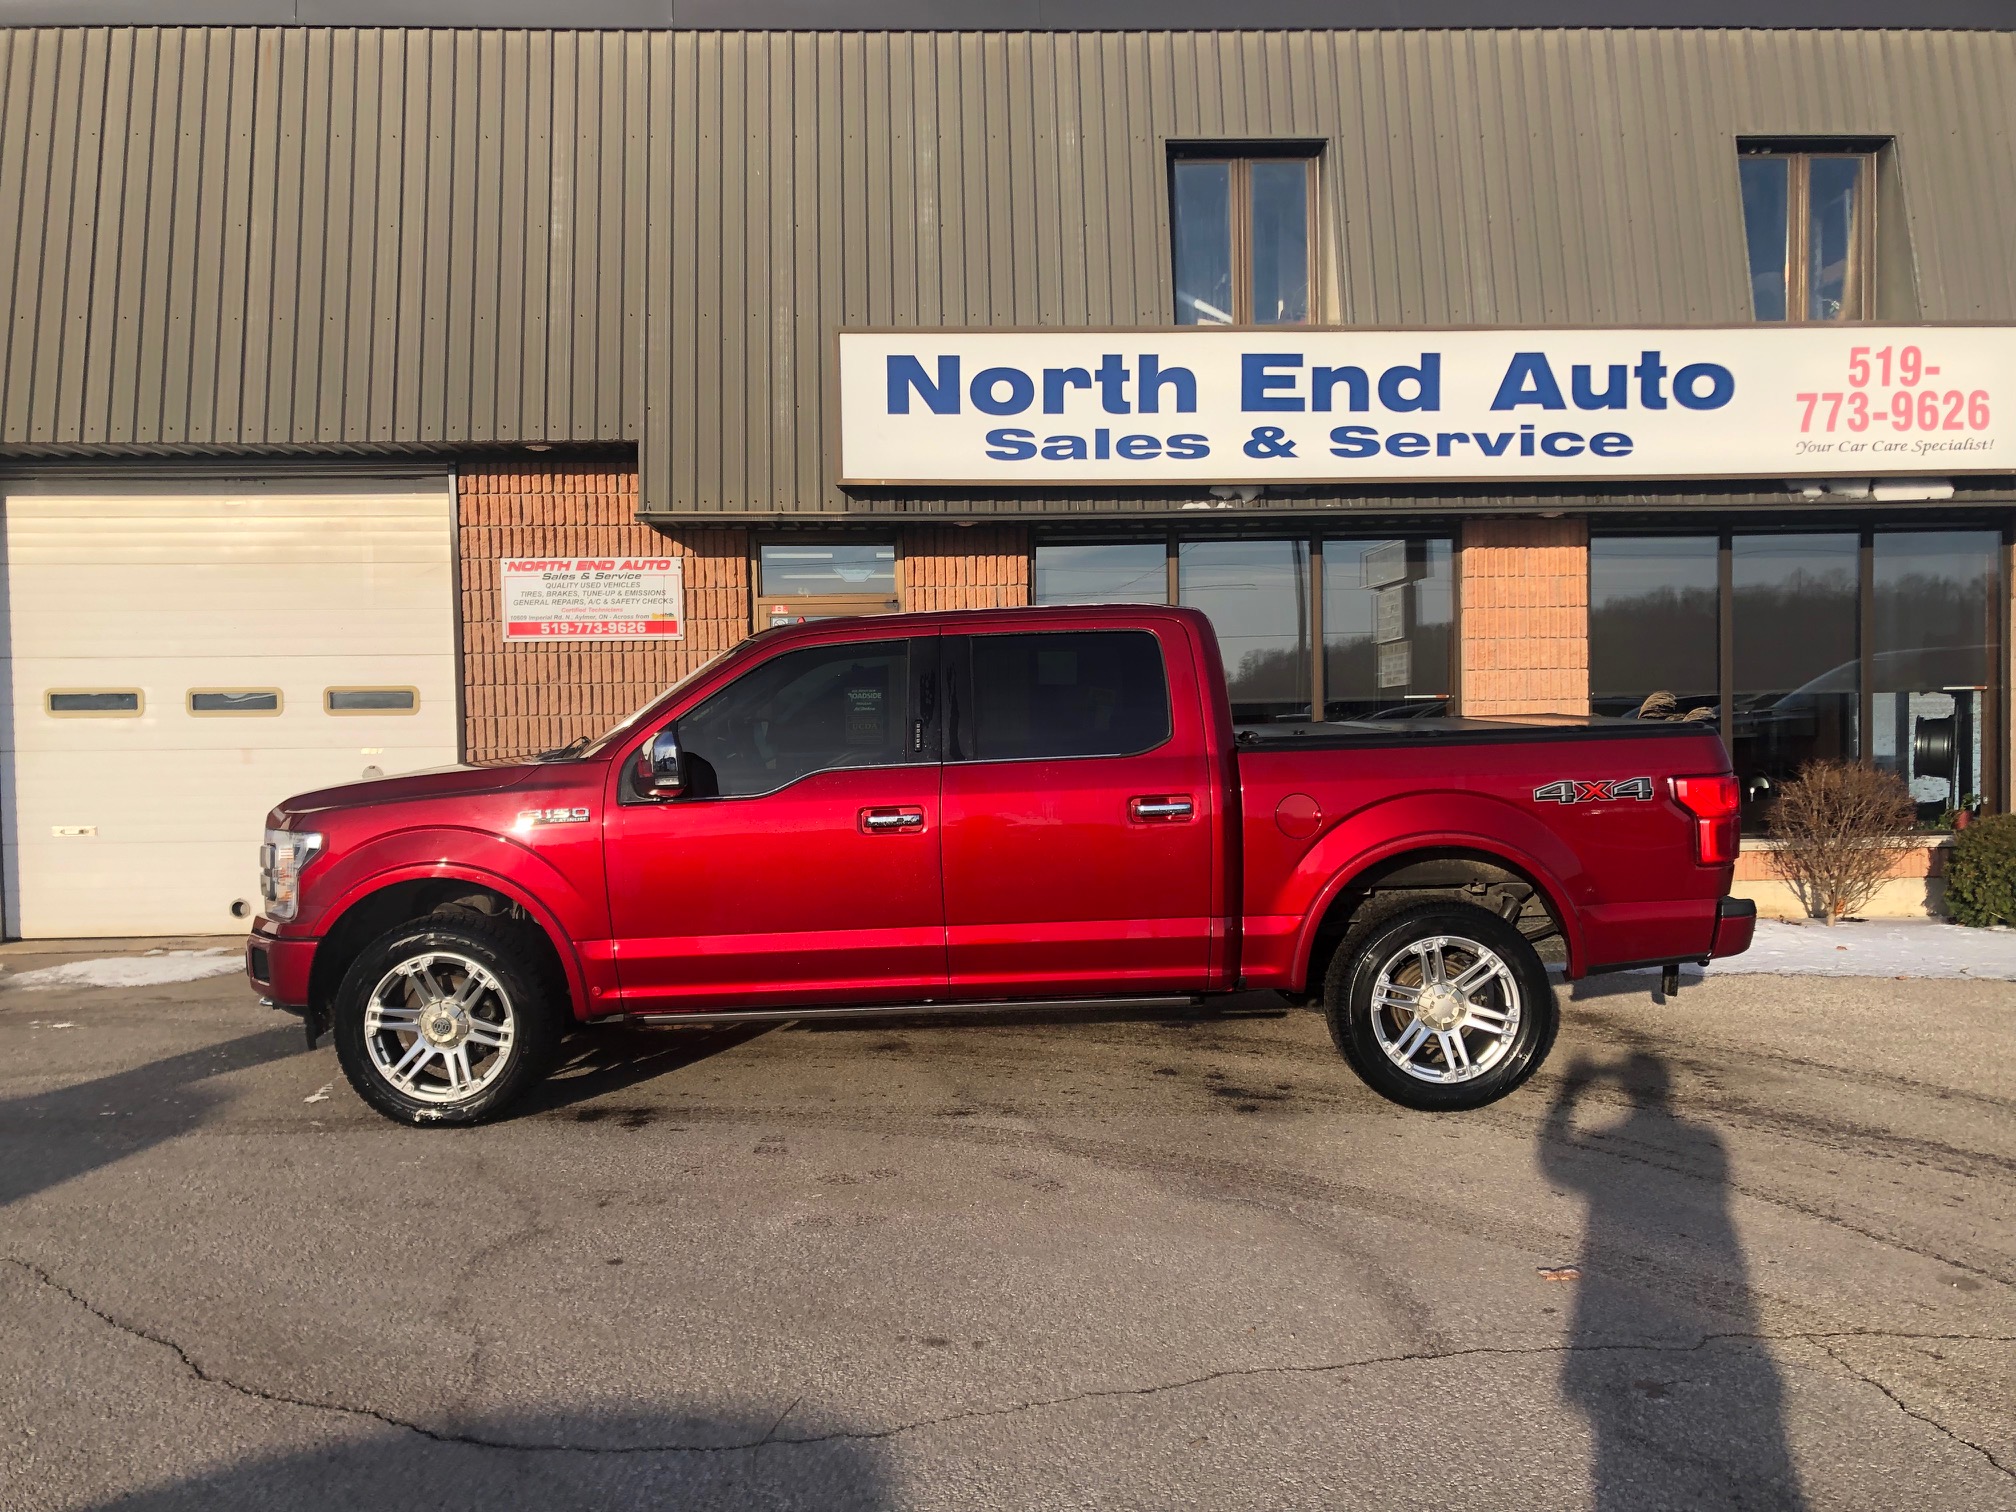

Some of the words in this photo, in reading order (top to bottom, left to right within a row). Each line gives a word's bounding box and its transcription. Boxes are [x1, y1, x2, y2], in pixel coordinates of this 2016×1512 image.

[1848, 346, 1941, 388] 519-
[887, 354, 1196, 416] North
[1241, 352, 1440, 413] End
[1490, 350, 1735, 411] Auto
[1796, 389, 1990, 433] 773-9626
[985, 428, 1210, 461] Sales
[1243, 426, 1299, 460] &
[1329, 424, 1633, 459] Service
[1795, 440, 1834, 456] Your
[1838, 440, 1868, 453] Car
[1871, 440, 1908, 453] Care
[1911, 437, 1995, 456] Specialist!
[507, 561, 572, 572] NORTH
[576, 560, 615, 572] END
[619, 560, 671, 571] AUTO
[542, 572, 576, 581] Sales
[581, 572, 590, 580] &
[595, 572, 642, 580] Service
[580, 581, 601, 589] USED
[546, 590, 580, 598] BRAKES,
[624, 589, 666, 597] EMISSIONS
[551, 598, 587, 606] REPAIRS,
[588, 598, 601, 606] A/C
[540, 622, 646, 634] 519-773-9626
